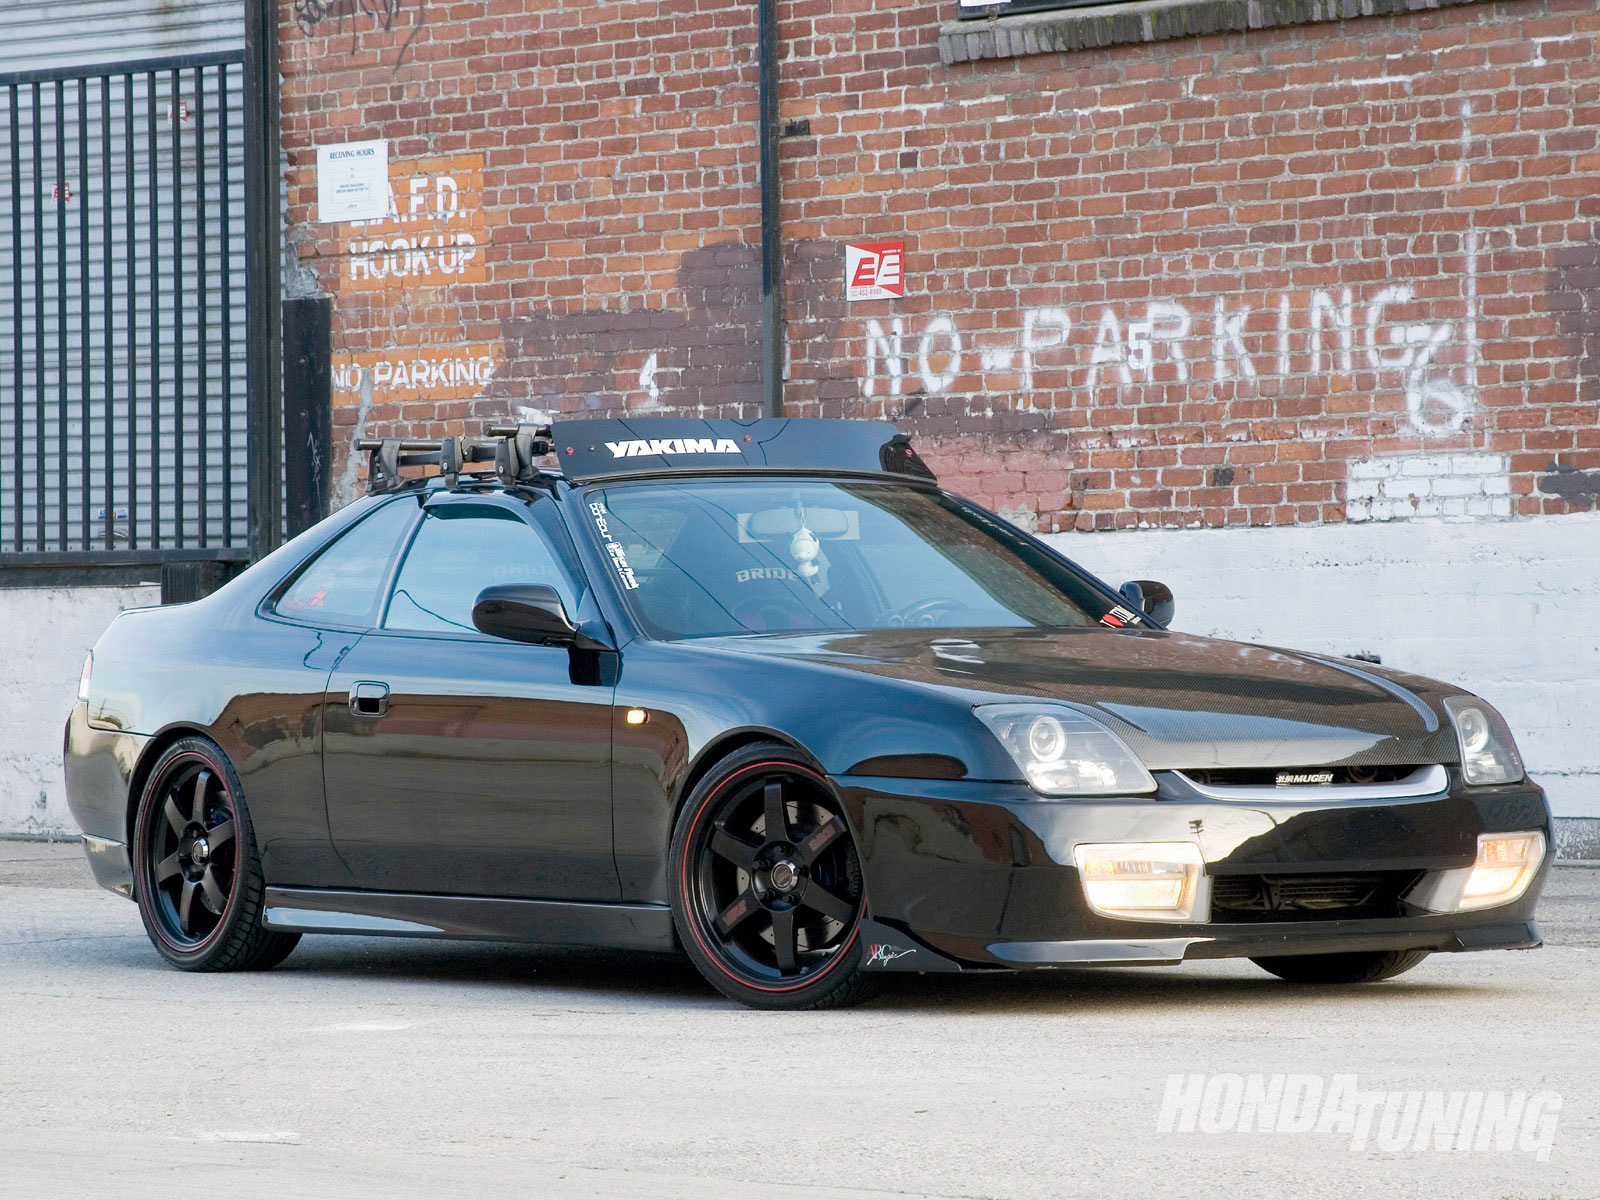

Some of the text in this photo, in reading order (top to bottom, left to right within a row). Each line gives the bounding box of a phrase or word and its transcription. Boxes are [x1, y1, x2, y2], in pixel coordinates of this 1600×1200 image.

[329, 147, 375, 159] RECEIVING HOURS
[374, 356, 495, 391] PARKING
[604, 438, 742, 458] YAKIMA
[735, 567, 798, 583] BRIDE
[1294, 774, 1334, 783] MUGEN
